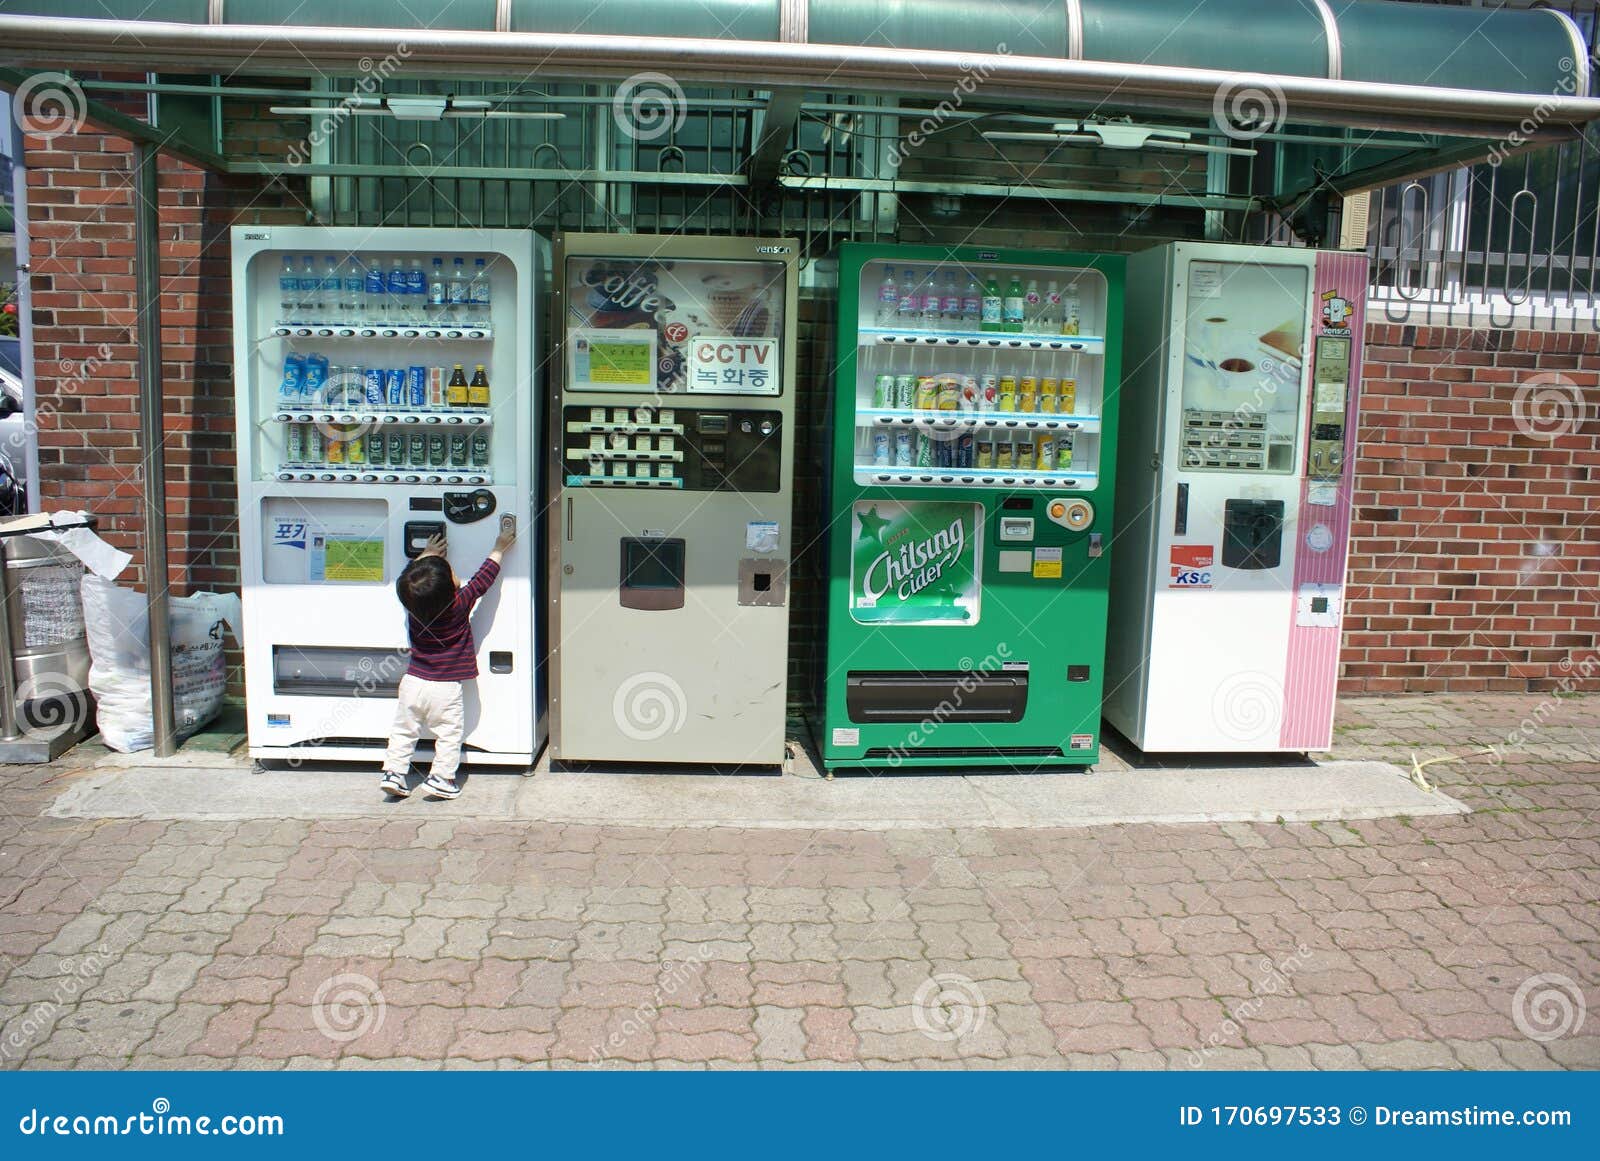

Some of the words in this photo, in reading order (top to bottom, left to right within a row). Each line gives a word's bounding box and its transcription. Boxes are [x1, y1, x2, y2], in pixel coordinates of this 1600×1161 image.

[755, 246, 791, 254] venson
[580, 267, 673, 322] Coffee
[697, 343, 770, 364] CCTV
[697, 367, 768, 388] 녹화중
[863, 517, 965, 600] Chilsung
[897, 552, 952, 601] Cider
[1176, 572, 1211, 584] KSC
